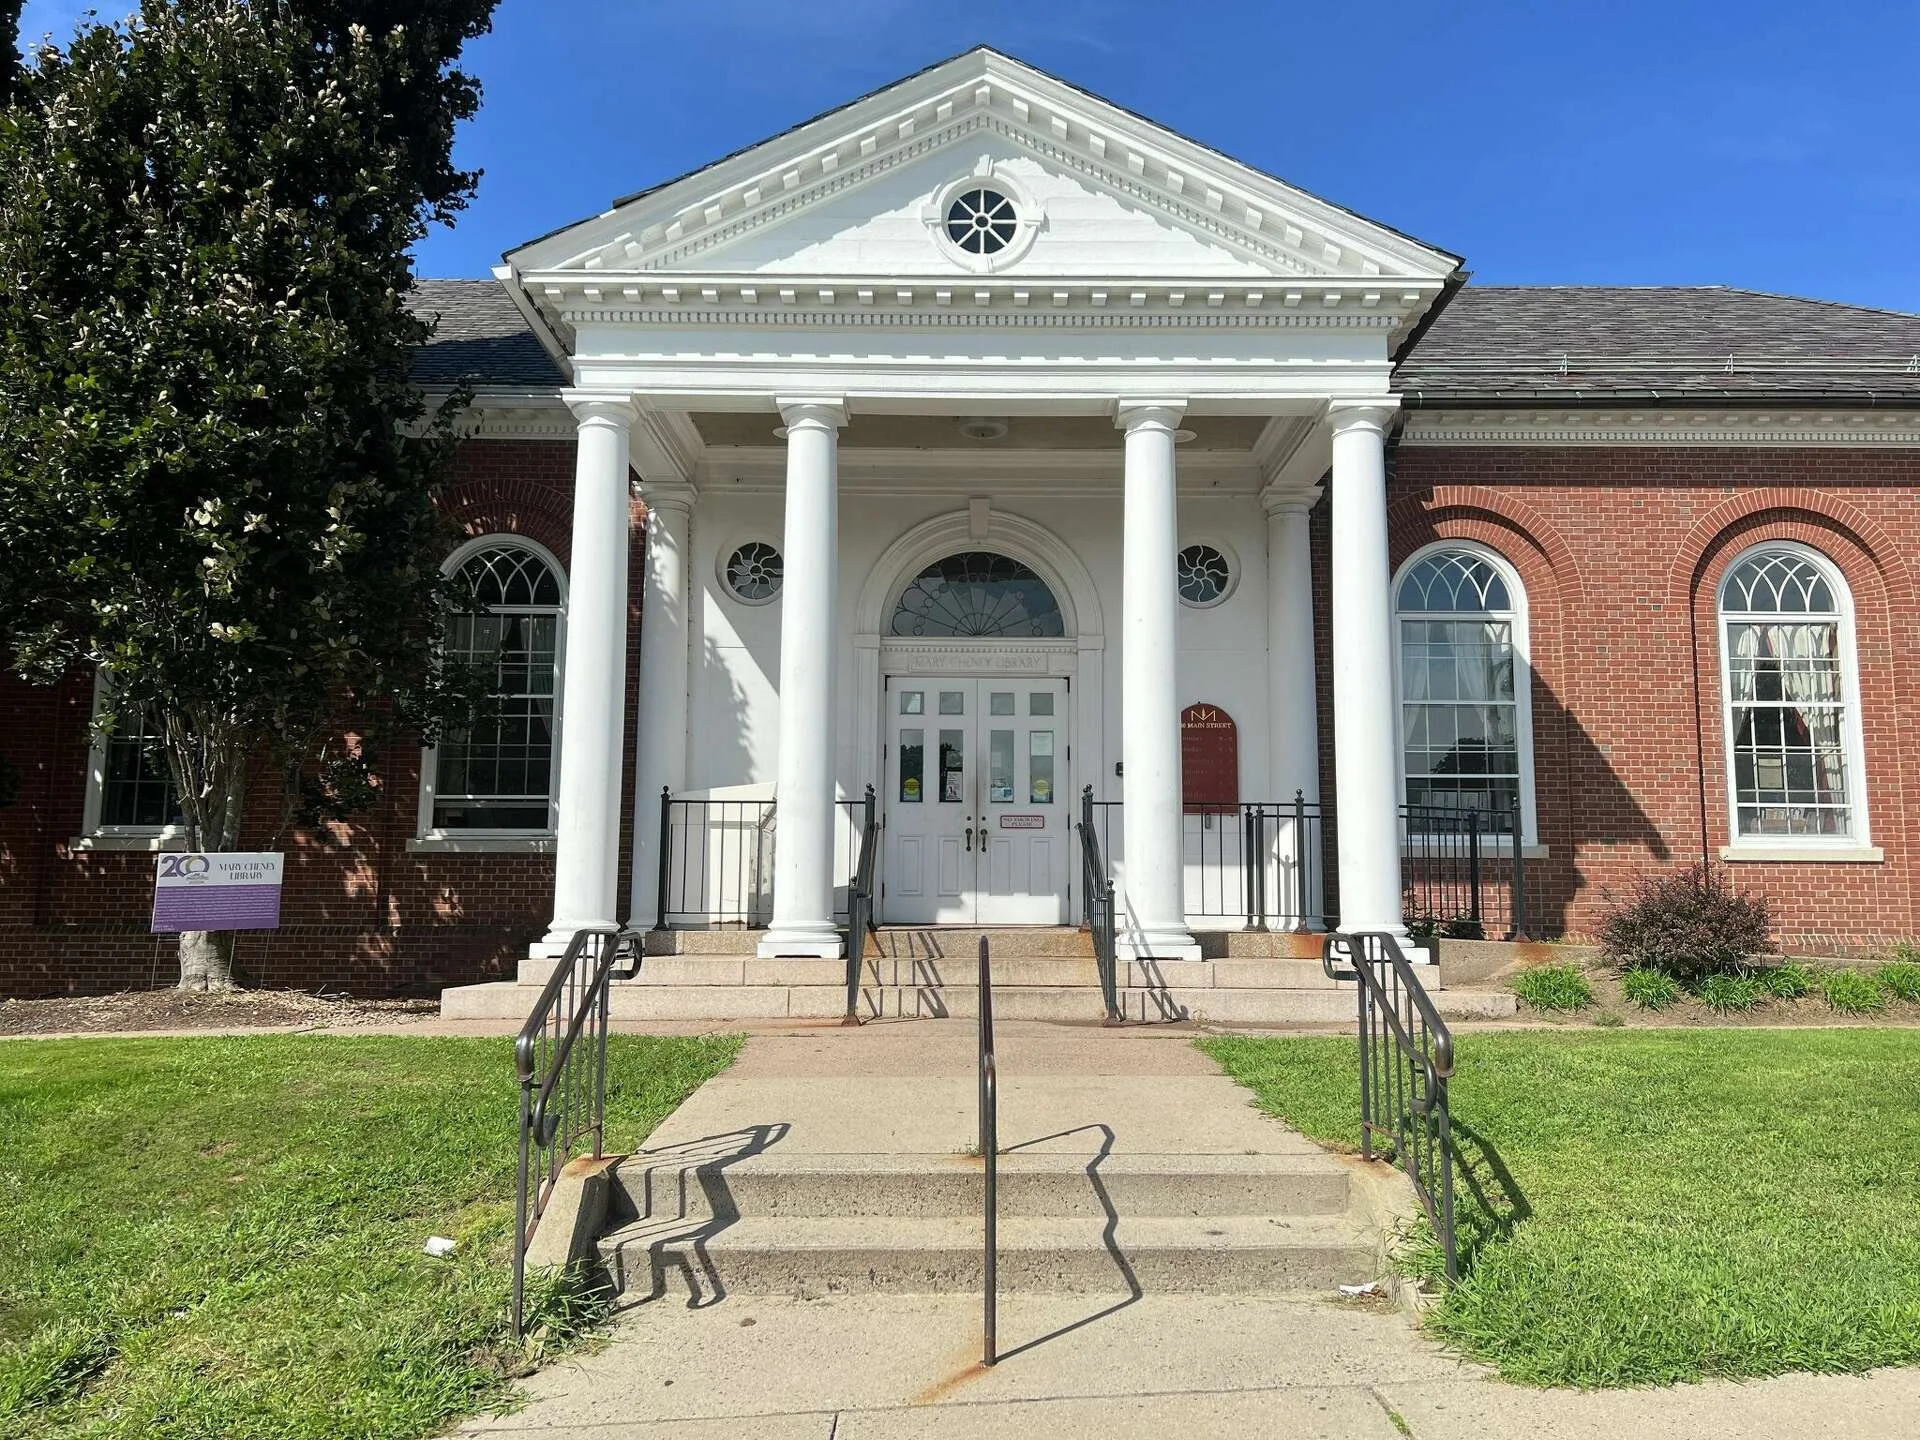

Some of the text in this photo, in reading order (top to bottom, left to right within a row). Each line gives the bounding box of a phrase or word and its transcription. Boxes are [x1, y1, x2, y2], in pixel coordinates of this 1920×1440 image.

[913, 655, 1041, 669] MARY CHENEY LIBRARY
[160, 855, 210, 877] 200
[219, 862, 275, 871] MARY CHENEY
[230, 872, 263, 881] LIBRARY
